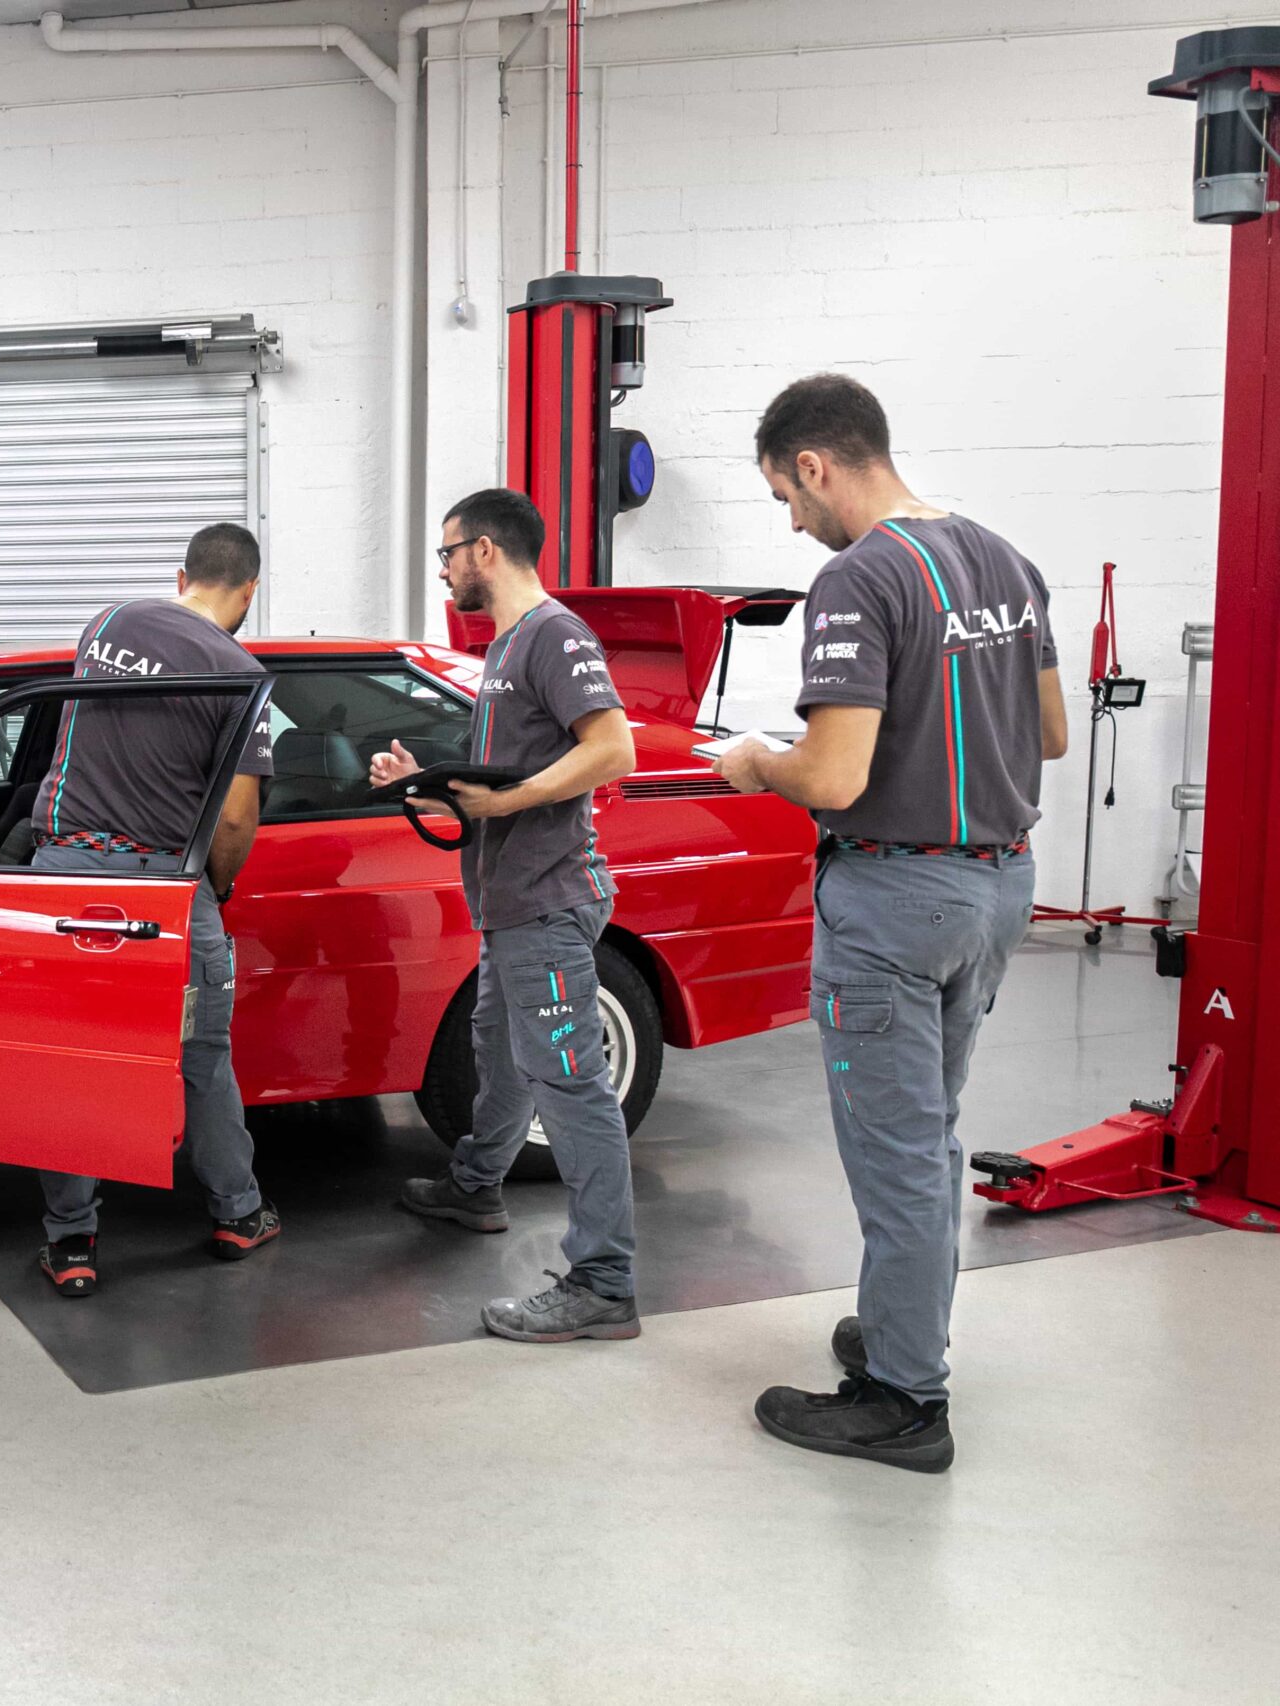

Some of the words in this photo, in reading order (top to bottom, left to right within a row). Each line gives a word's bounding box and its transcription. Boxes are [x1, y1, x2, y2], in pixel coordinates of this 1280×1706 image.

[824, 642, 860, 652] ANEST
[826, 650, 857, 659] IWATA
[552, 1022, 576, 1042] BML
